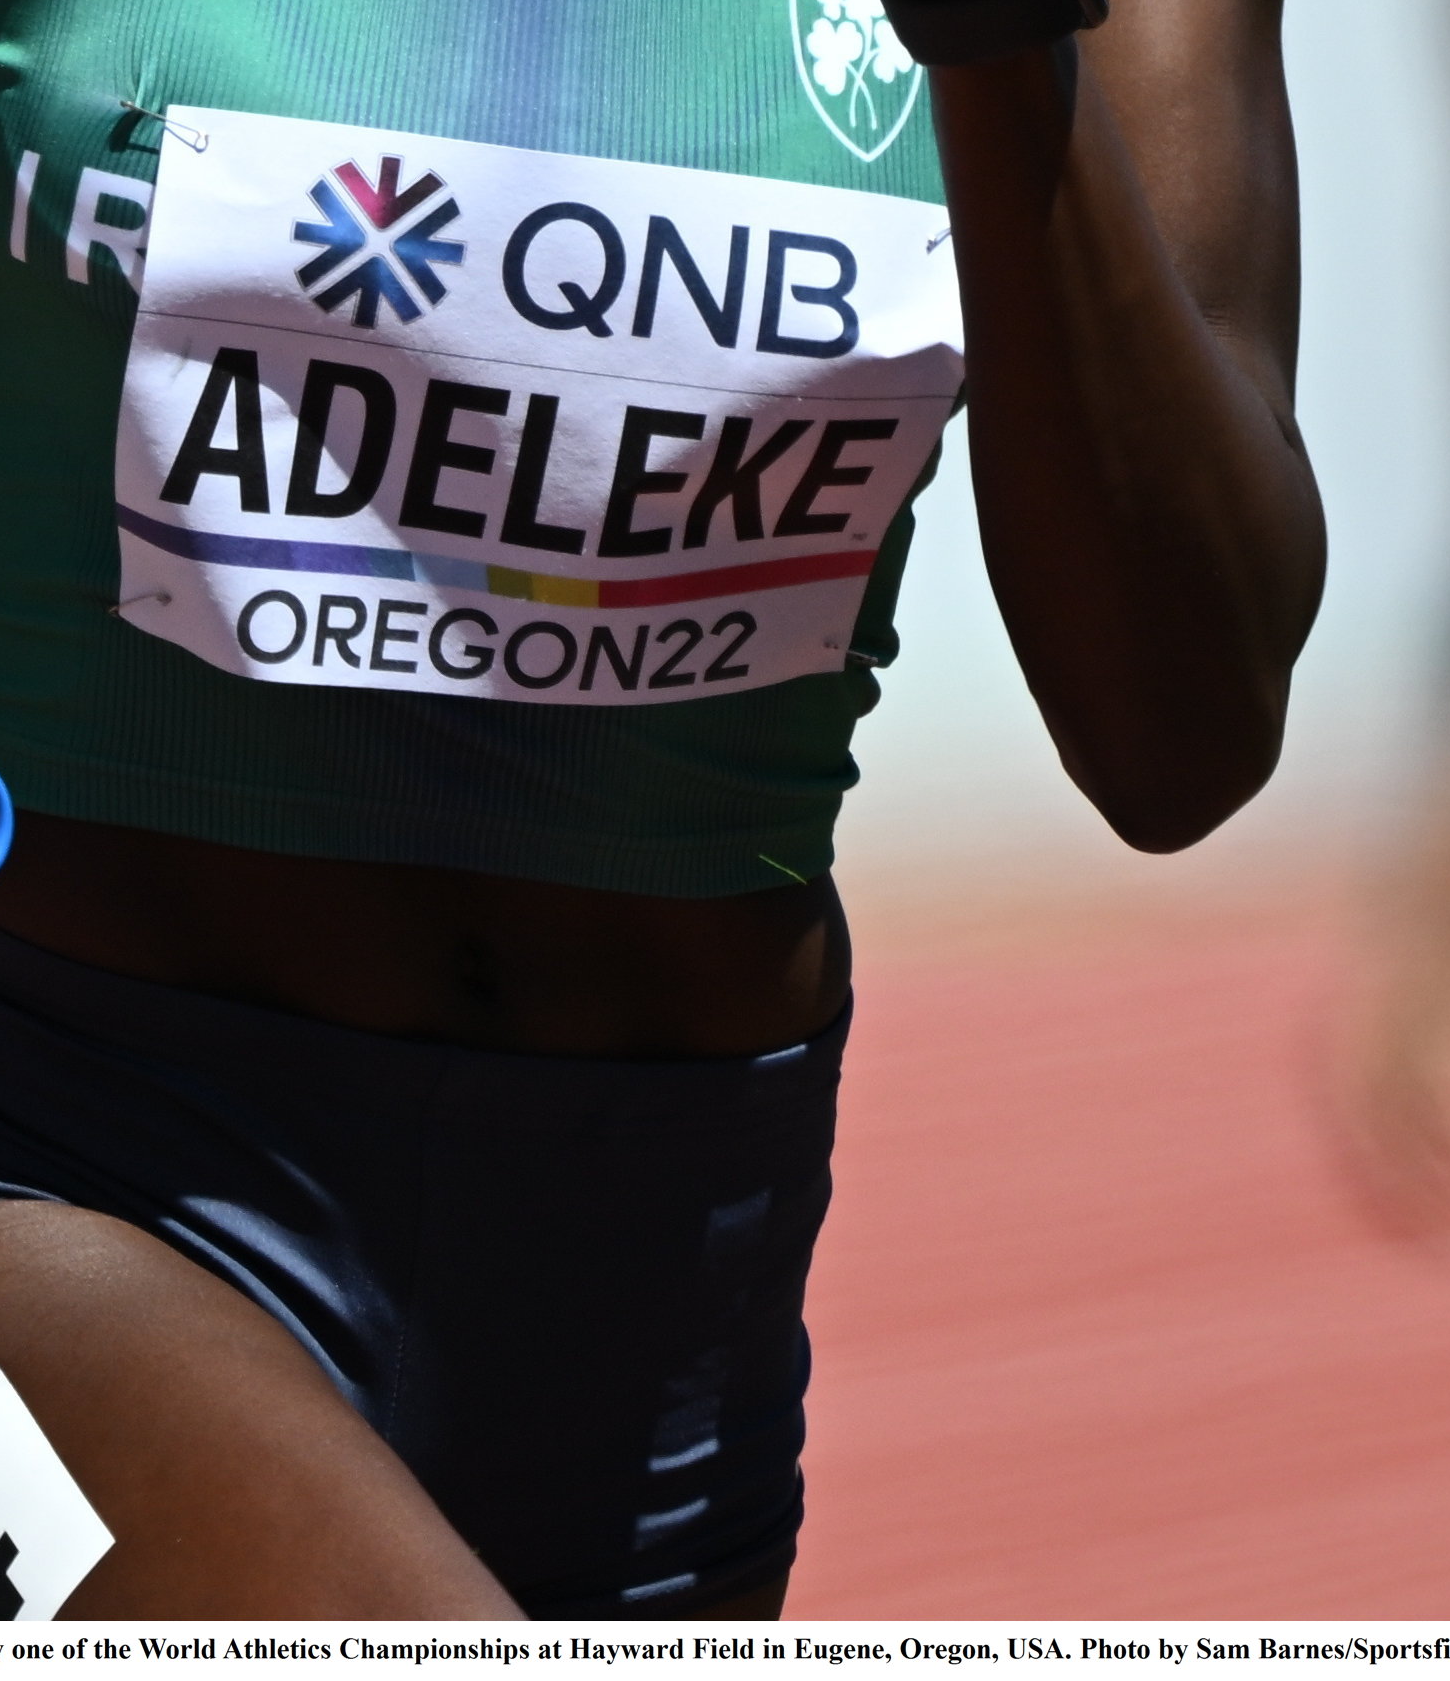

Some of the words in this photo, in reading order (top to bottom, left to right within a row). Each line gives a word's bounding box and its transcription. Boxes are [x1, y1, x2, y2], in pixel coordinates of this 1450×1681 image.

[501, 200, 861, 360] QNB
[158, 346, 900, 560] ADELEKE
[236, 599, 759, 693] OREGON22
